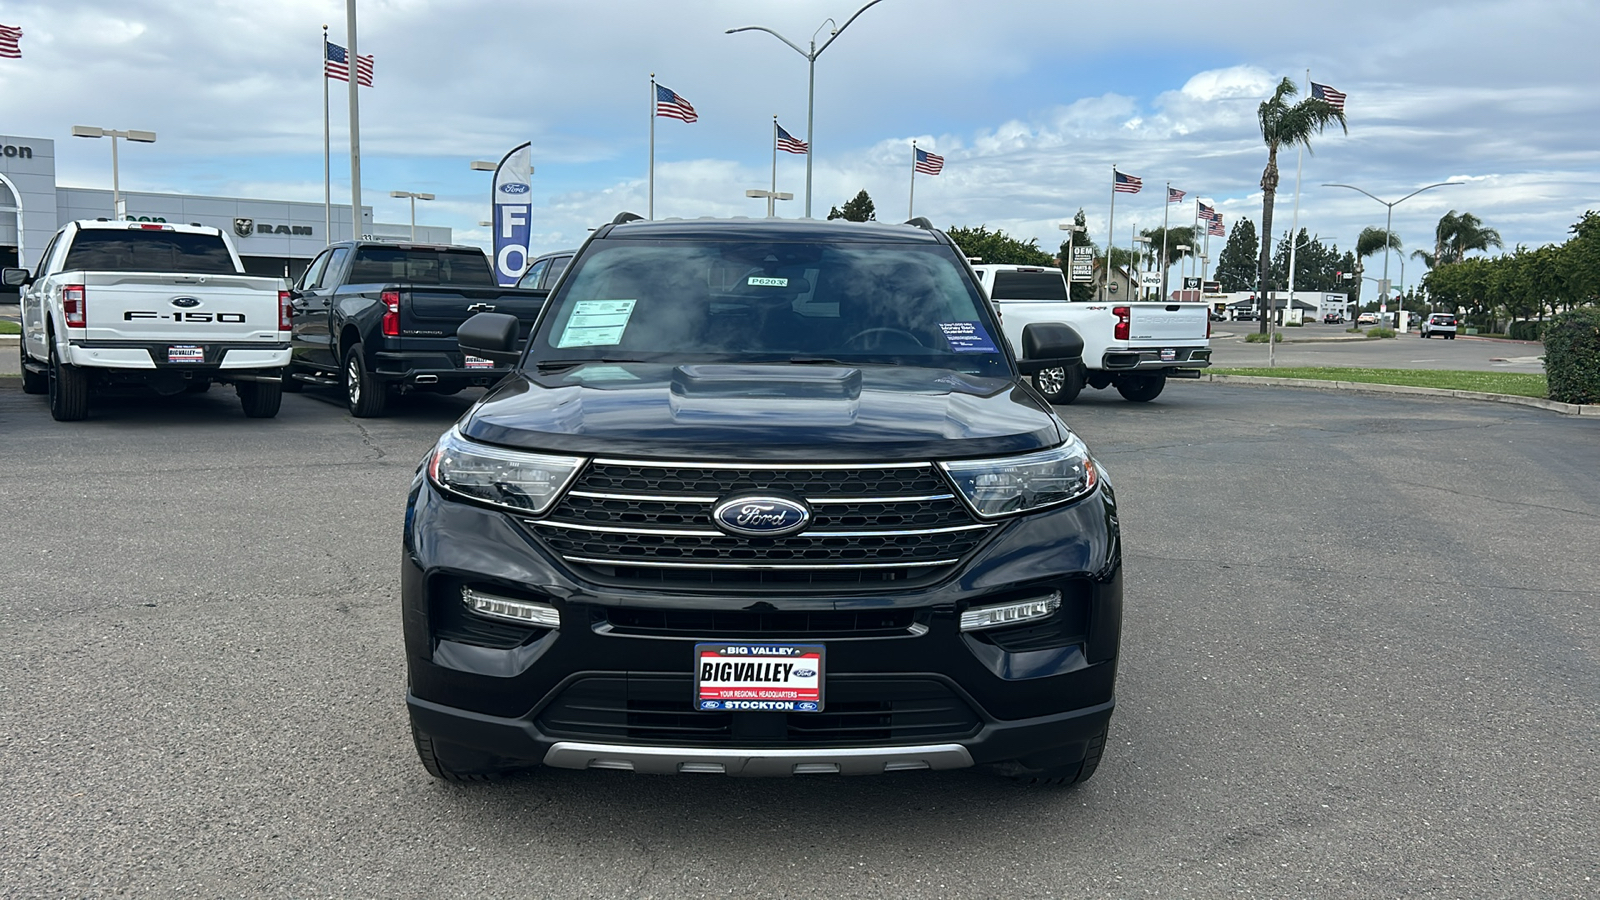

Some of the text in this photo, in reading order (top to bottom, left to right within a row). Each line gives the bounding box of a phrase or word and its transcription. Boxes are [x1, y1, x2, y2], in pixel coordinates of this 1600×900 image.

[0, 143, 32, 159] on
[504, 183, 526, 194] Ford
[257, 224, 313, 236] RAM
[498, 205, 528, 287] FO
[1074, 247, 1093, 255] OEM
[1143, 276, 1161, 284] Jeep
[124, 311, 246, 323] F-150
[1136, 315, 1204, 325] CHEVROLET
[736, 504, 787, 525] Ford
[727, 646, 794, 655] BIG VALLEY
[701, 662, 794, 682] BIGVALLEY
[720, 690, 798, 699] YOUR REGIONAL HEADQUARTERS
[725, 701, 794, 710] STOCKTON
